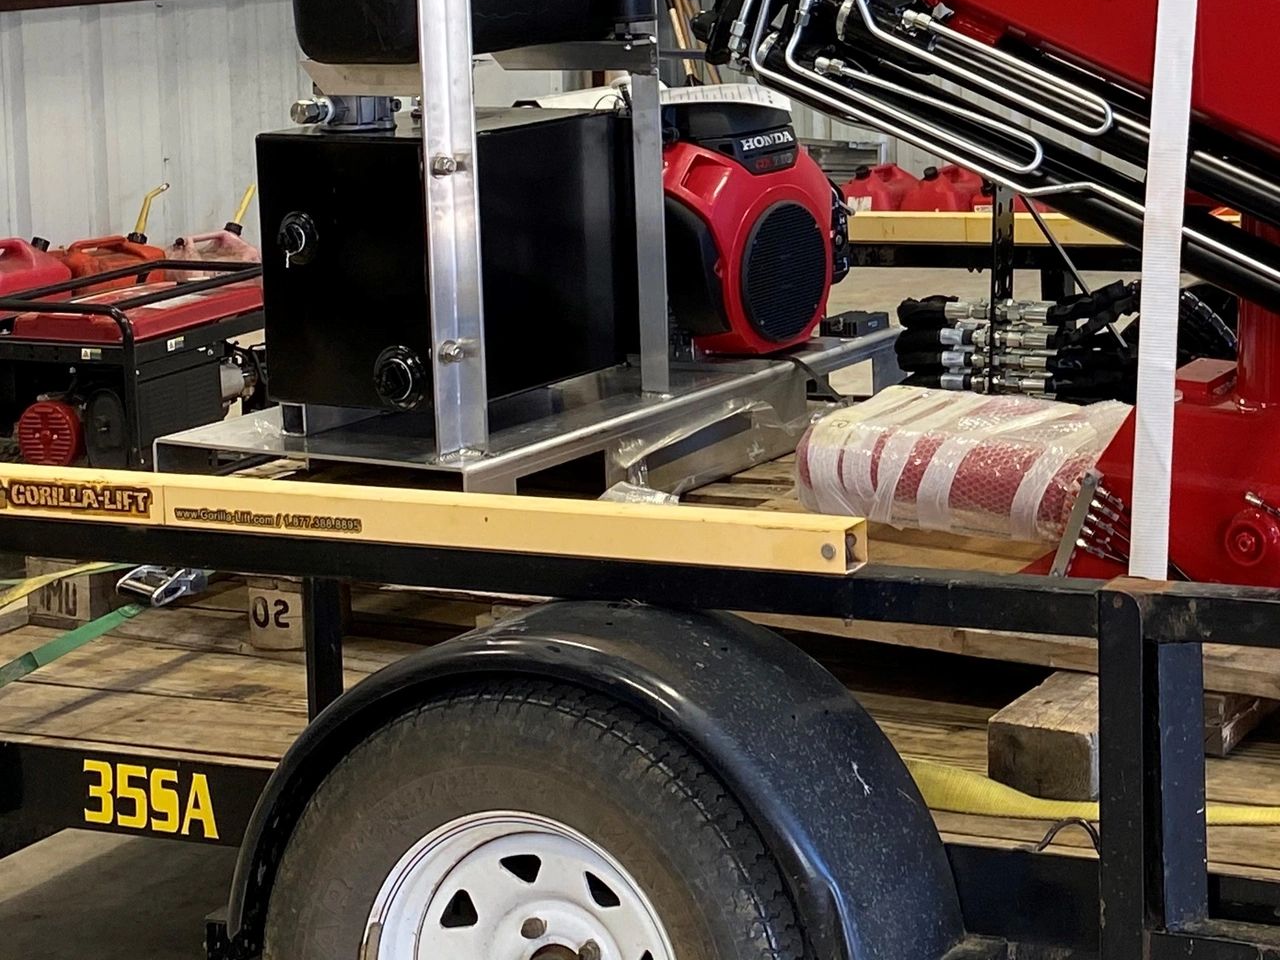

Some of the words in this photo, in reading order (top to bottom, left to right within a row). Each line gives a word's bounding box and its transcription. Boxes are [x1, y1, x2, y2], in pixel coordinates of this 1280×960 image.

[740, 131, 794, 151] HONDA
[10, 483, 149, 513] GORILLA-LIFT
[83, 759, 219, 839] 35SA
